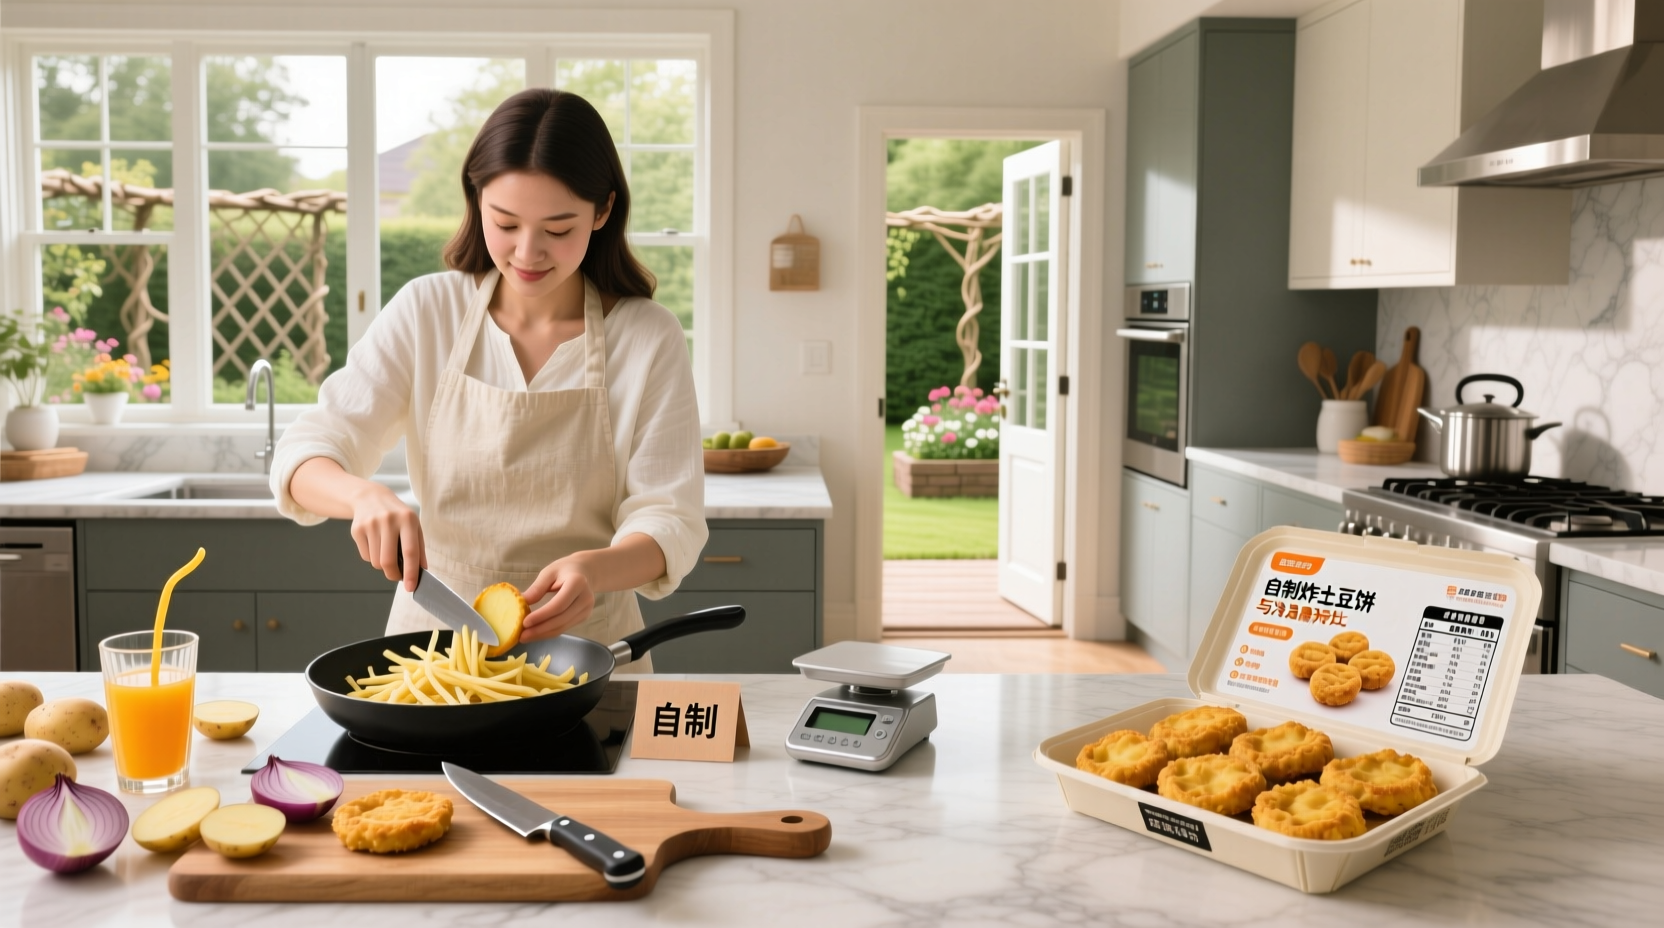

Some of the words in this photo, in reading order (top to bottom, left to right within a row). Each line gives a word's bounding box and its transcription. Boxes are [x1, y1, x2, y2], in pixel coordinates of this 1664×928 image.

[1264, 577, 1377, 613] 自制炸土豆饼
[653, 701, 719, 739] 自制
